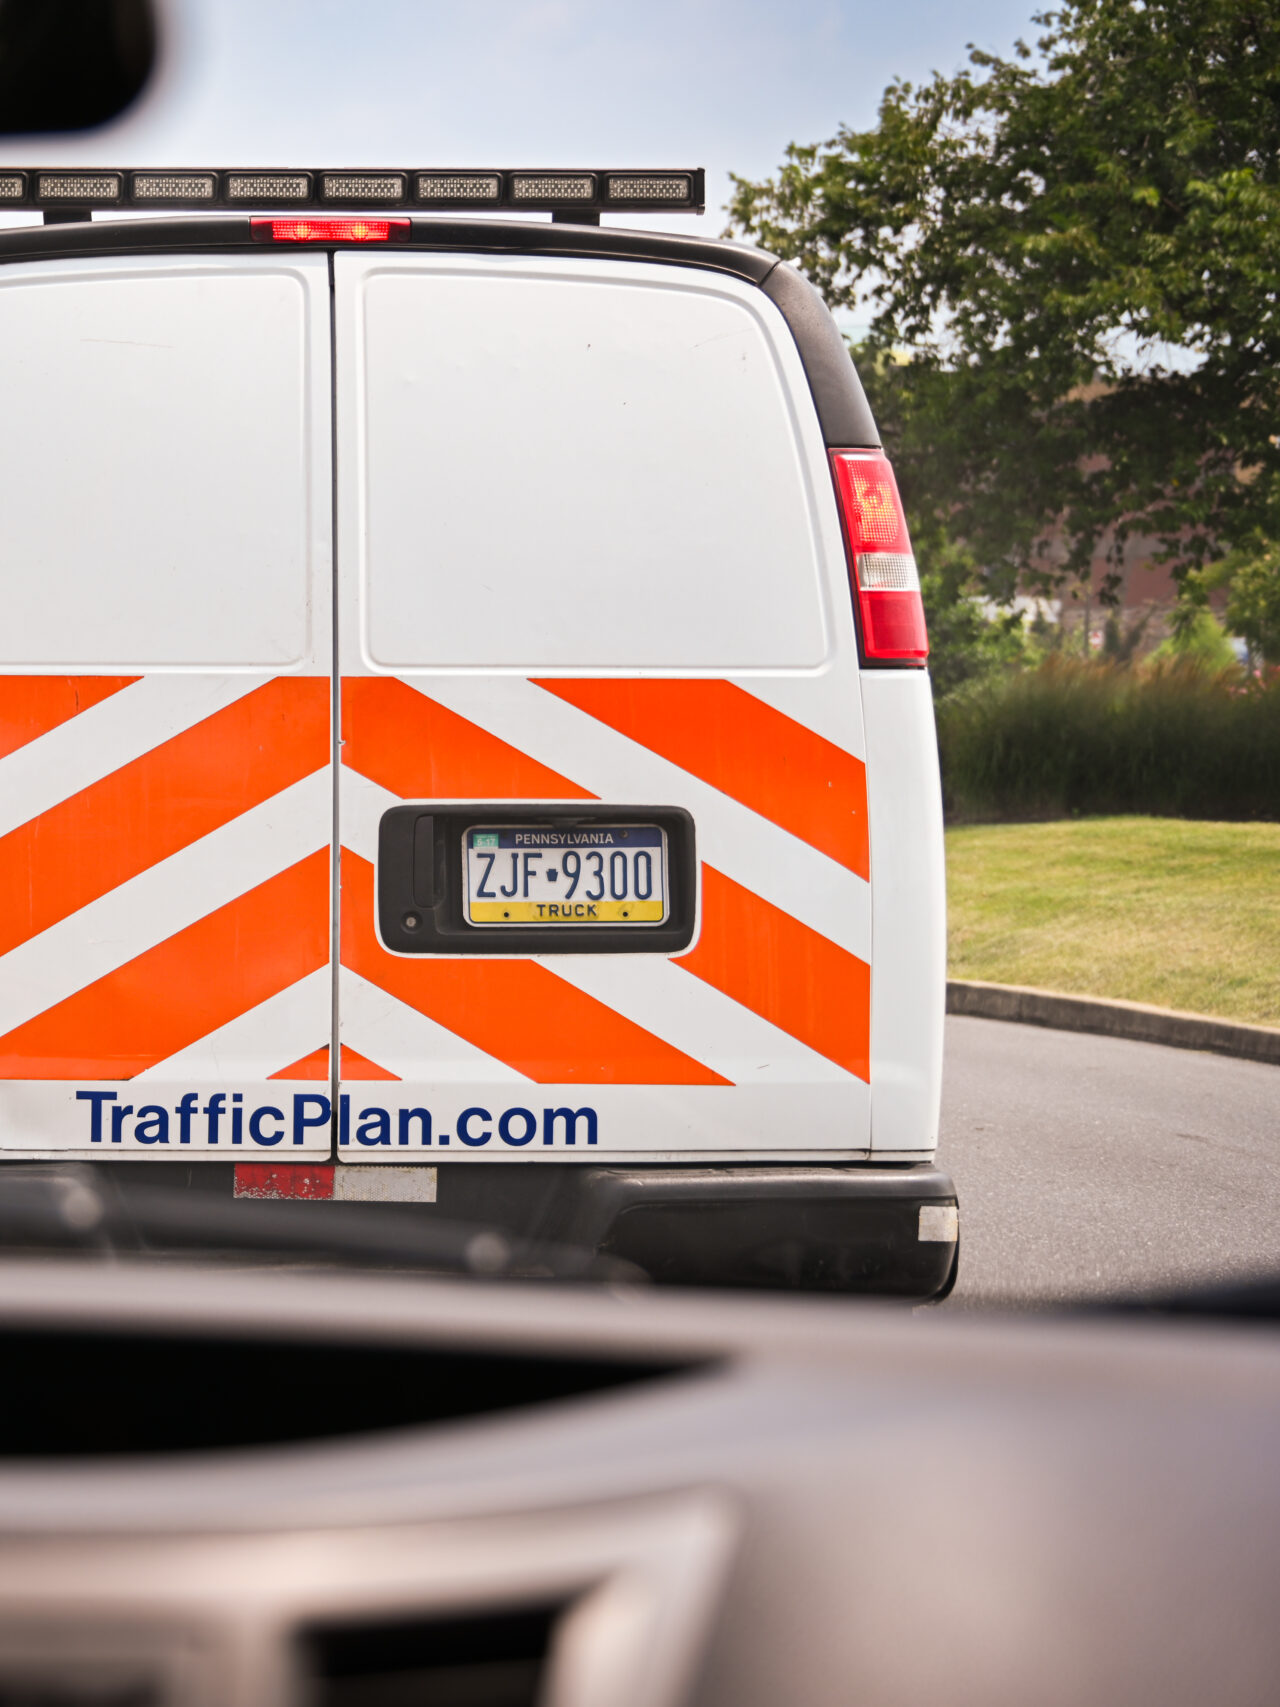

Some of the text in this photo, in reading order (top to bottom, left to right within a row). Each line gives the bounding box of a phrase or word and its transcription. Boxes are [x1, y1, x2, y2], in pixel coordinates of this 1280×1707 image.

[515, 833, 614, 845] PENNSYLVANIA
[536, 904, 597, 918] TRUCK
[75, 1090, 599, 1147] TrafficPlan.com
